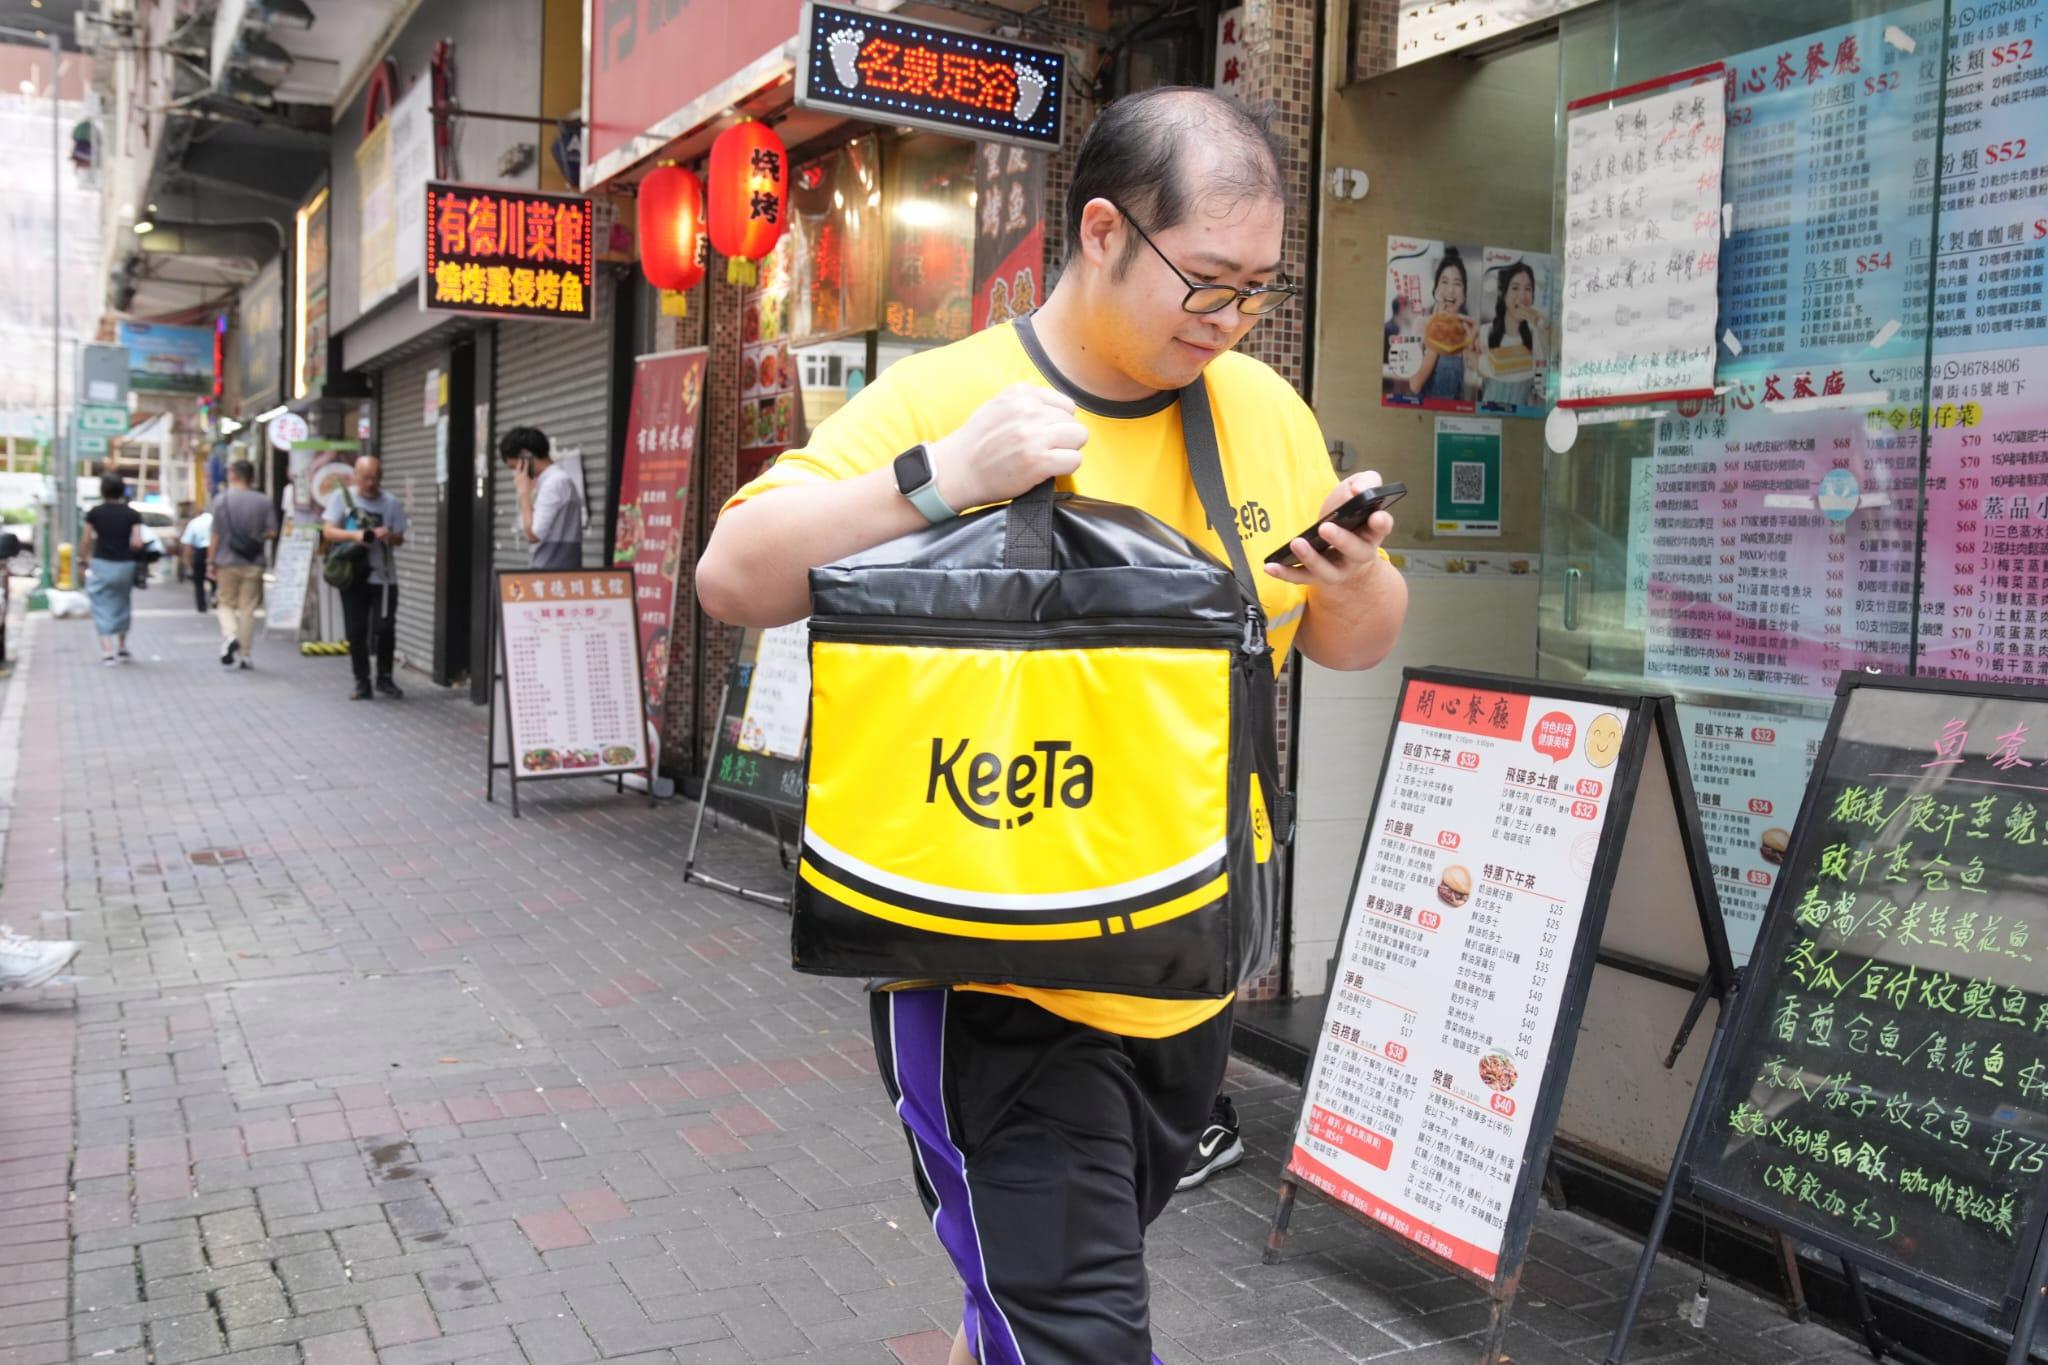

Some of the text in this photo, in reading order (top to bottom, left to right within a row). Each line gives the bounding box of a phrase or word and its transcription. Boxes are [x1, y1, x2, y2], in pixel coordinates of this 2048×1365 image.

[1990, 39, 2033, 68] $52
[858, 37, 1017, 112] 名泉足浴
[1984, 138, 2027, 166] $52
[437, 192, 584, 265] 有德川菜館
[1856, 251, 1892, 275] $54
[1959, 358, 2020, 377] 46784806
[1960, 434, 1981, 447] $70
[1960, 456, 1980, 468] $70
[1959, 478, 1979, 490] $70
[1958, 499, 1977, 511] $68
[1956, 521, 1976, 532] $68
[1955, 542, 1975, 553] $68
[1954, 563, 1974, 575] $68
[1953, 584, 1973, 596] $68
[1952, 606, 1972, 617] $70
[1952, 627, 1971, 639] $70
[1950, 648, 1970, 660] $76
[1415, 688, 1511, 730] 開心餐廳
[1694, 722, 1773, 741] 超值下午茶 $32
[1919, 716, 2048, 771] 鱼套
[1403, 742, 1477, 767] 超值下午茶 $32
[926, 737, 1093, 830] KeeTa
[1505, 767, 1599, 796] 飛碟多士餐 $30
[1574, 802, 1594, 818] $32
[1751, 801, 1769, 813] $34
[1384, 817, 1458, 846] 扒飽餐 $34
[1483, 863, 1537, 890] 特惠下午茶
[1751, 872, 1768, 884] $38
[1549, 903, 1564, 916] $25
[1420, 911, 1438, 927] $38
[1546, 918, 1560, 930] $25
[1542, 931, 1557, 944] $27
[1539, 946, 1554, 959] $30
[1535, 960, 1550, 973] $35
[1532, 975, 1546, 987] $27
[1528, 989, 1543, 1002] $40
[1525, 1003, 1540, 1017] $40
[1403, 1013, 1417, 1025] $17
[1521, 1018, 1536, 1031] $40
[1330, 1020, 1361, 1044] 百搭餐
[1400, 1026, 1414, 1038] $17
[1518, 1032, 1533, 1046] $40
[1514, 1046, 1529, 1060] $40
[1431, 1068, 1512, 1113] 常餐 $40
